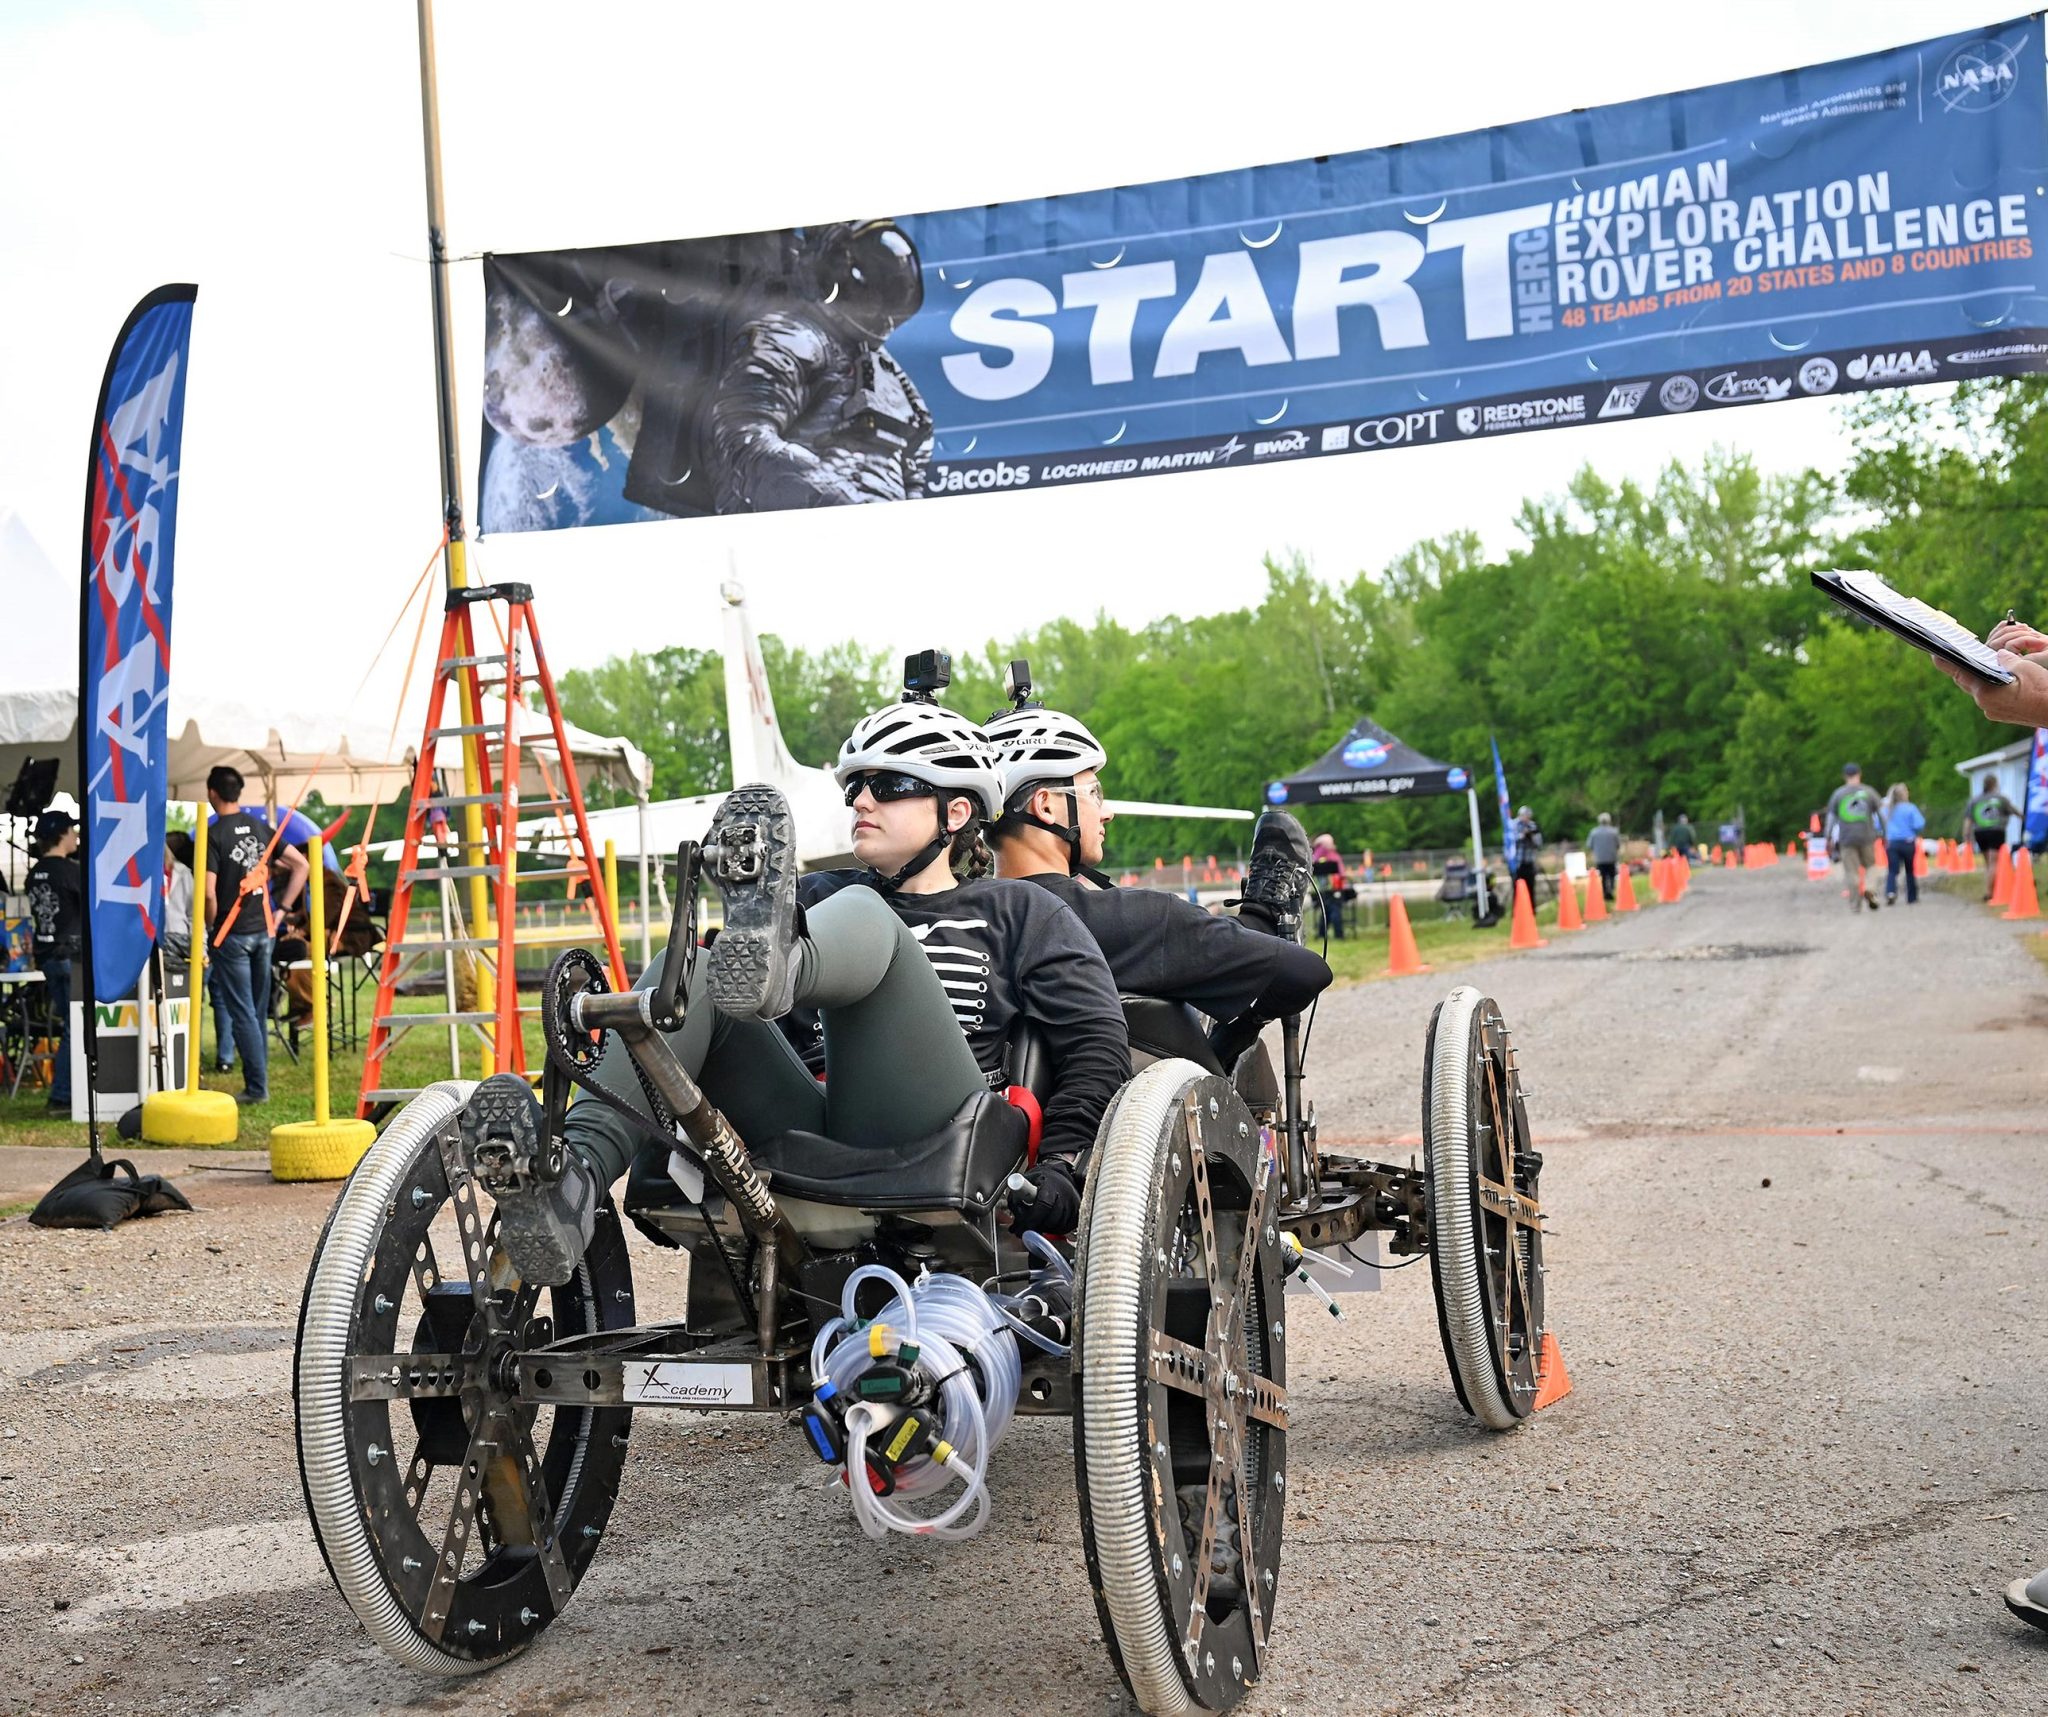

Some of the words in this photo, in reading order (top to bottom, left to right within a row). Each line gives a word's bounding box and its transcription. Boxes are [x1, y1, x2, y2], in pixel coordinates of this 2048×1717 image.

[1943, 63, 2013, 89] NASA
[1759, 106, 1809, 124] National
[1811, 87, 1882, 109] Aeronautics
[1884, 81, 1907, 96] and
[1781, 109, 1819, 127] Space
[1822, 96, 1906, 118] Administration
[1555, 159, 1728, 224] HUMAN
[1555, 171, 1891, 263] EXPLORATION
[1557, 246, 1714, 305] ROVER
[1733, 194, 2028, 274] CHALLENGE
[1514, 228, 1554, 334] HERC
[1561, 307, 1586, 328] 48
[1590, 296, 1659, 322] TEAMS
[1663, 281, 1721, 309] FROM
[1727, 275, 1753, 298] 20
[1758, 263, 1835, 293] STATES
[1840, 256, 1886, 283] AND
[1891, 253, 1906, 274] 8
[1911, 237, 2033, 273] COUNTRIES
[941, 202, 1554, 401] START
[1867, 350, 1934, 376] AIAA
[1483, 395, 1586, 423] REDSTONE
[1484, 419, 1522, 432] FEDERAL
[1523, 416, 1555, 428] CREDIT
[1555, 411, 1586, 424] UNION
[1353, 409, 1445, 447] COPT
[928, 461, 1030, 493] Jacobs
[1041, 458, 1138, 481] LOCKHEED
[1140, 450, 1215, 471] MARTIN
[95, 349, 179, 916] NASA
[1016, 738, 1047, 746] GIRO
[1318, 777, 1415, 796] www.nasa.gov
